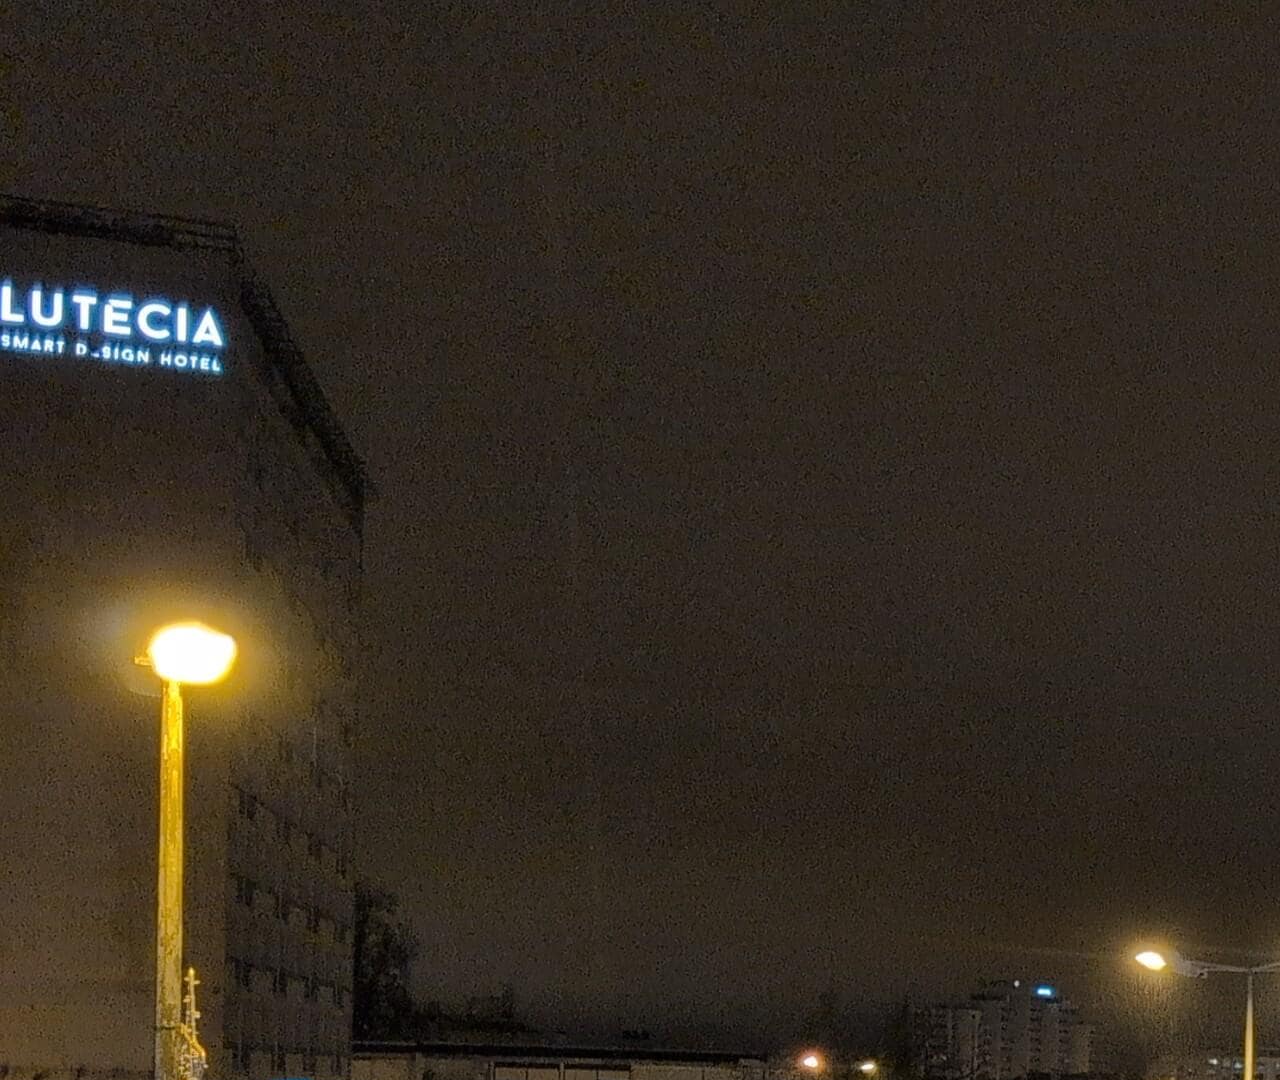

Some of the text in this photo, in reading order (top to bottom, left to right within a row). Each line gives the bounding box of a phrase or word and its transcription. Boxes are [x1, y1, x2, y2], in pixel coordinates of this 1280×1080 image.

[1, 284, 223, 347] LUTECIA
[1, 334, 222, 372] SMART DSIGN HOTEL
